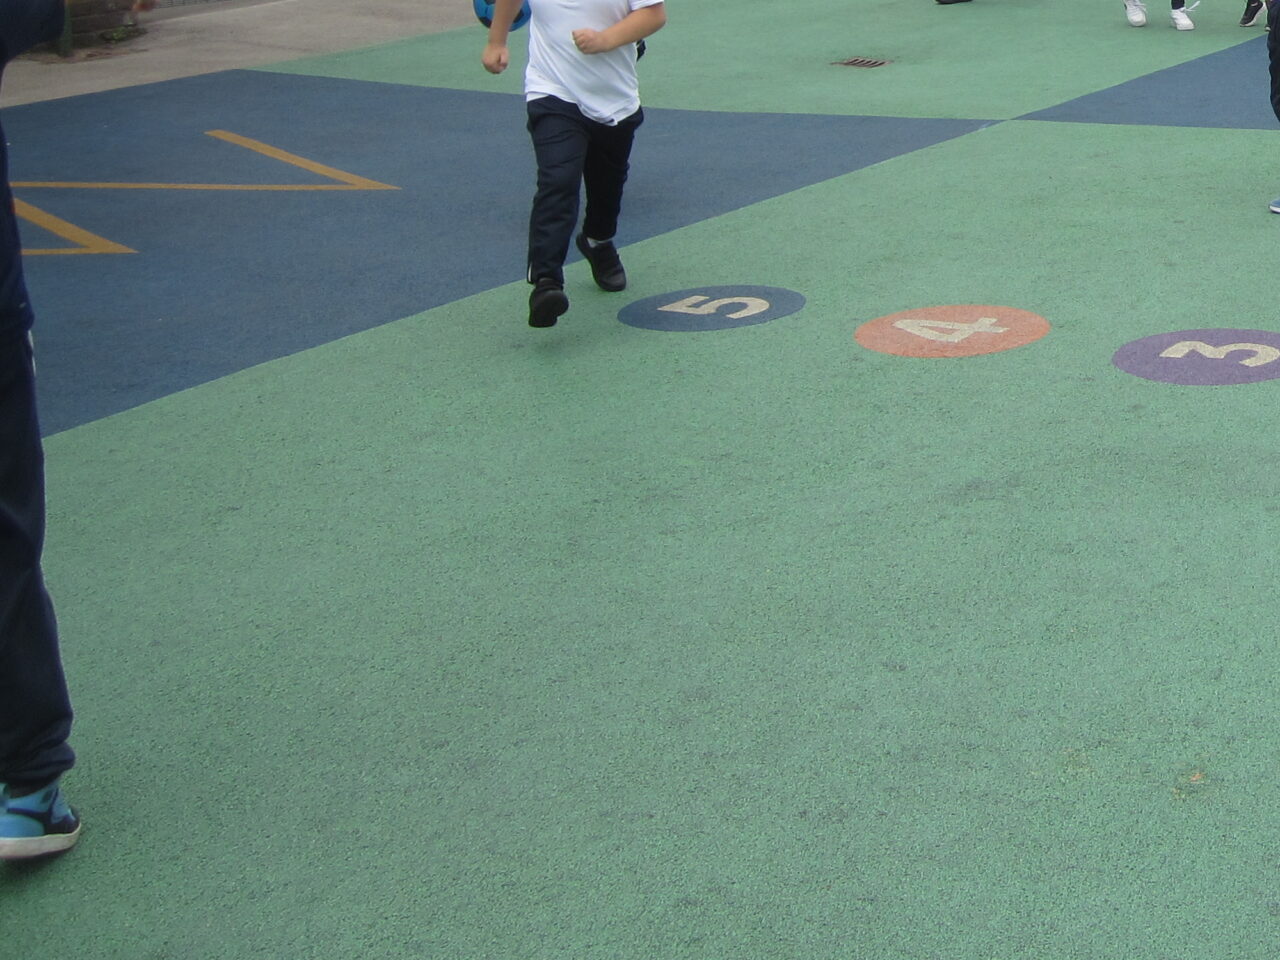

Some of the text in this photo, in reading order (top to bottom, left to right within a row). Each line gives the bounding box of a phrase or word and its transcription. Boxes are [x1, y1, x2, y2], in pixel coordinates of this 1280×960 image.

[657, 295, 770, 320] 5
[892, 316, 1010, 344] 4
[1159, 340, 1280, 368] 3
